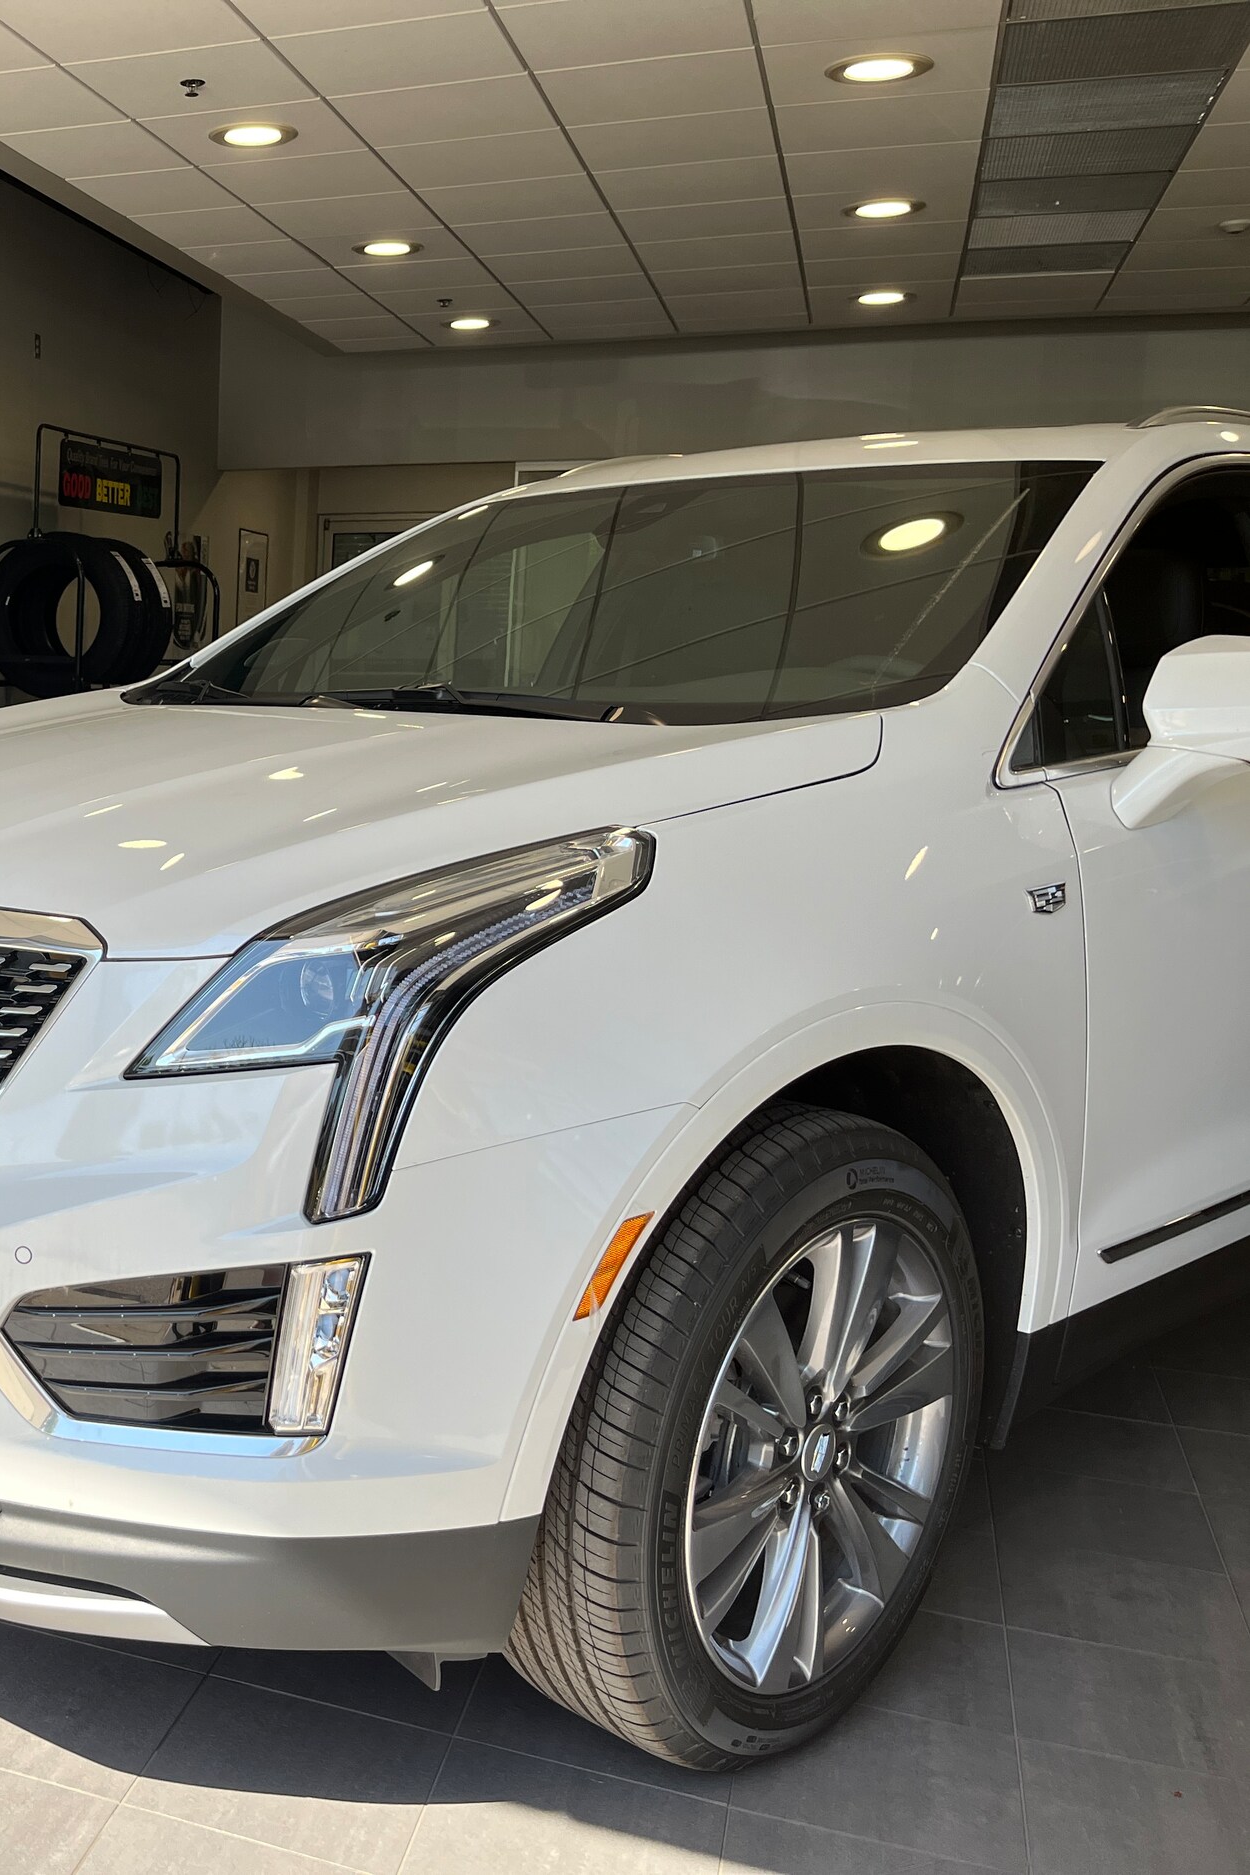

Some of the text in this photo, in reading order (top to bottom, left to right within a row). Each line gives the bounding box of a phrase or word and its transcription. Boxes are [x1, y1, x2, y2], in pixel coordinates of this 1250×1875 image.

[63, 471, 91, 500] GOOD
[96, 478, 131, 507] BETTER
[670, 1358, 708, 1469] PRIMACY
[707, 1297, 739, 1355] TOUR
[659, 1501, 696, 1669] MICHELIN
